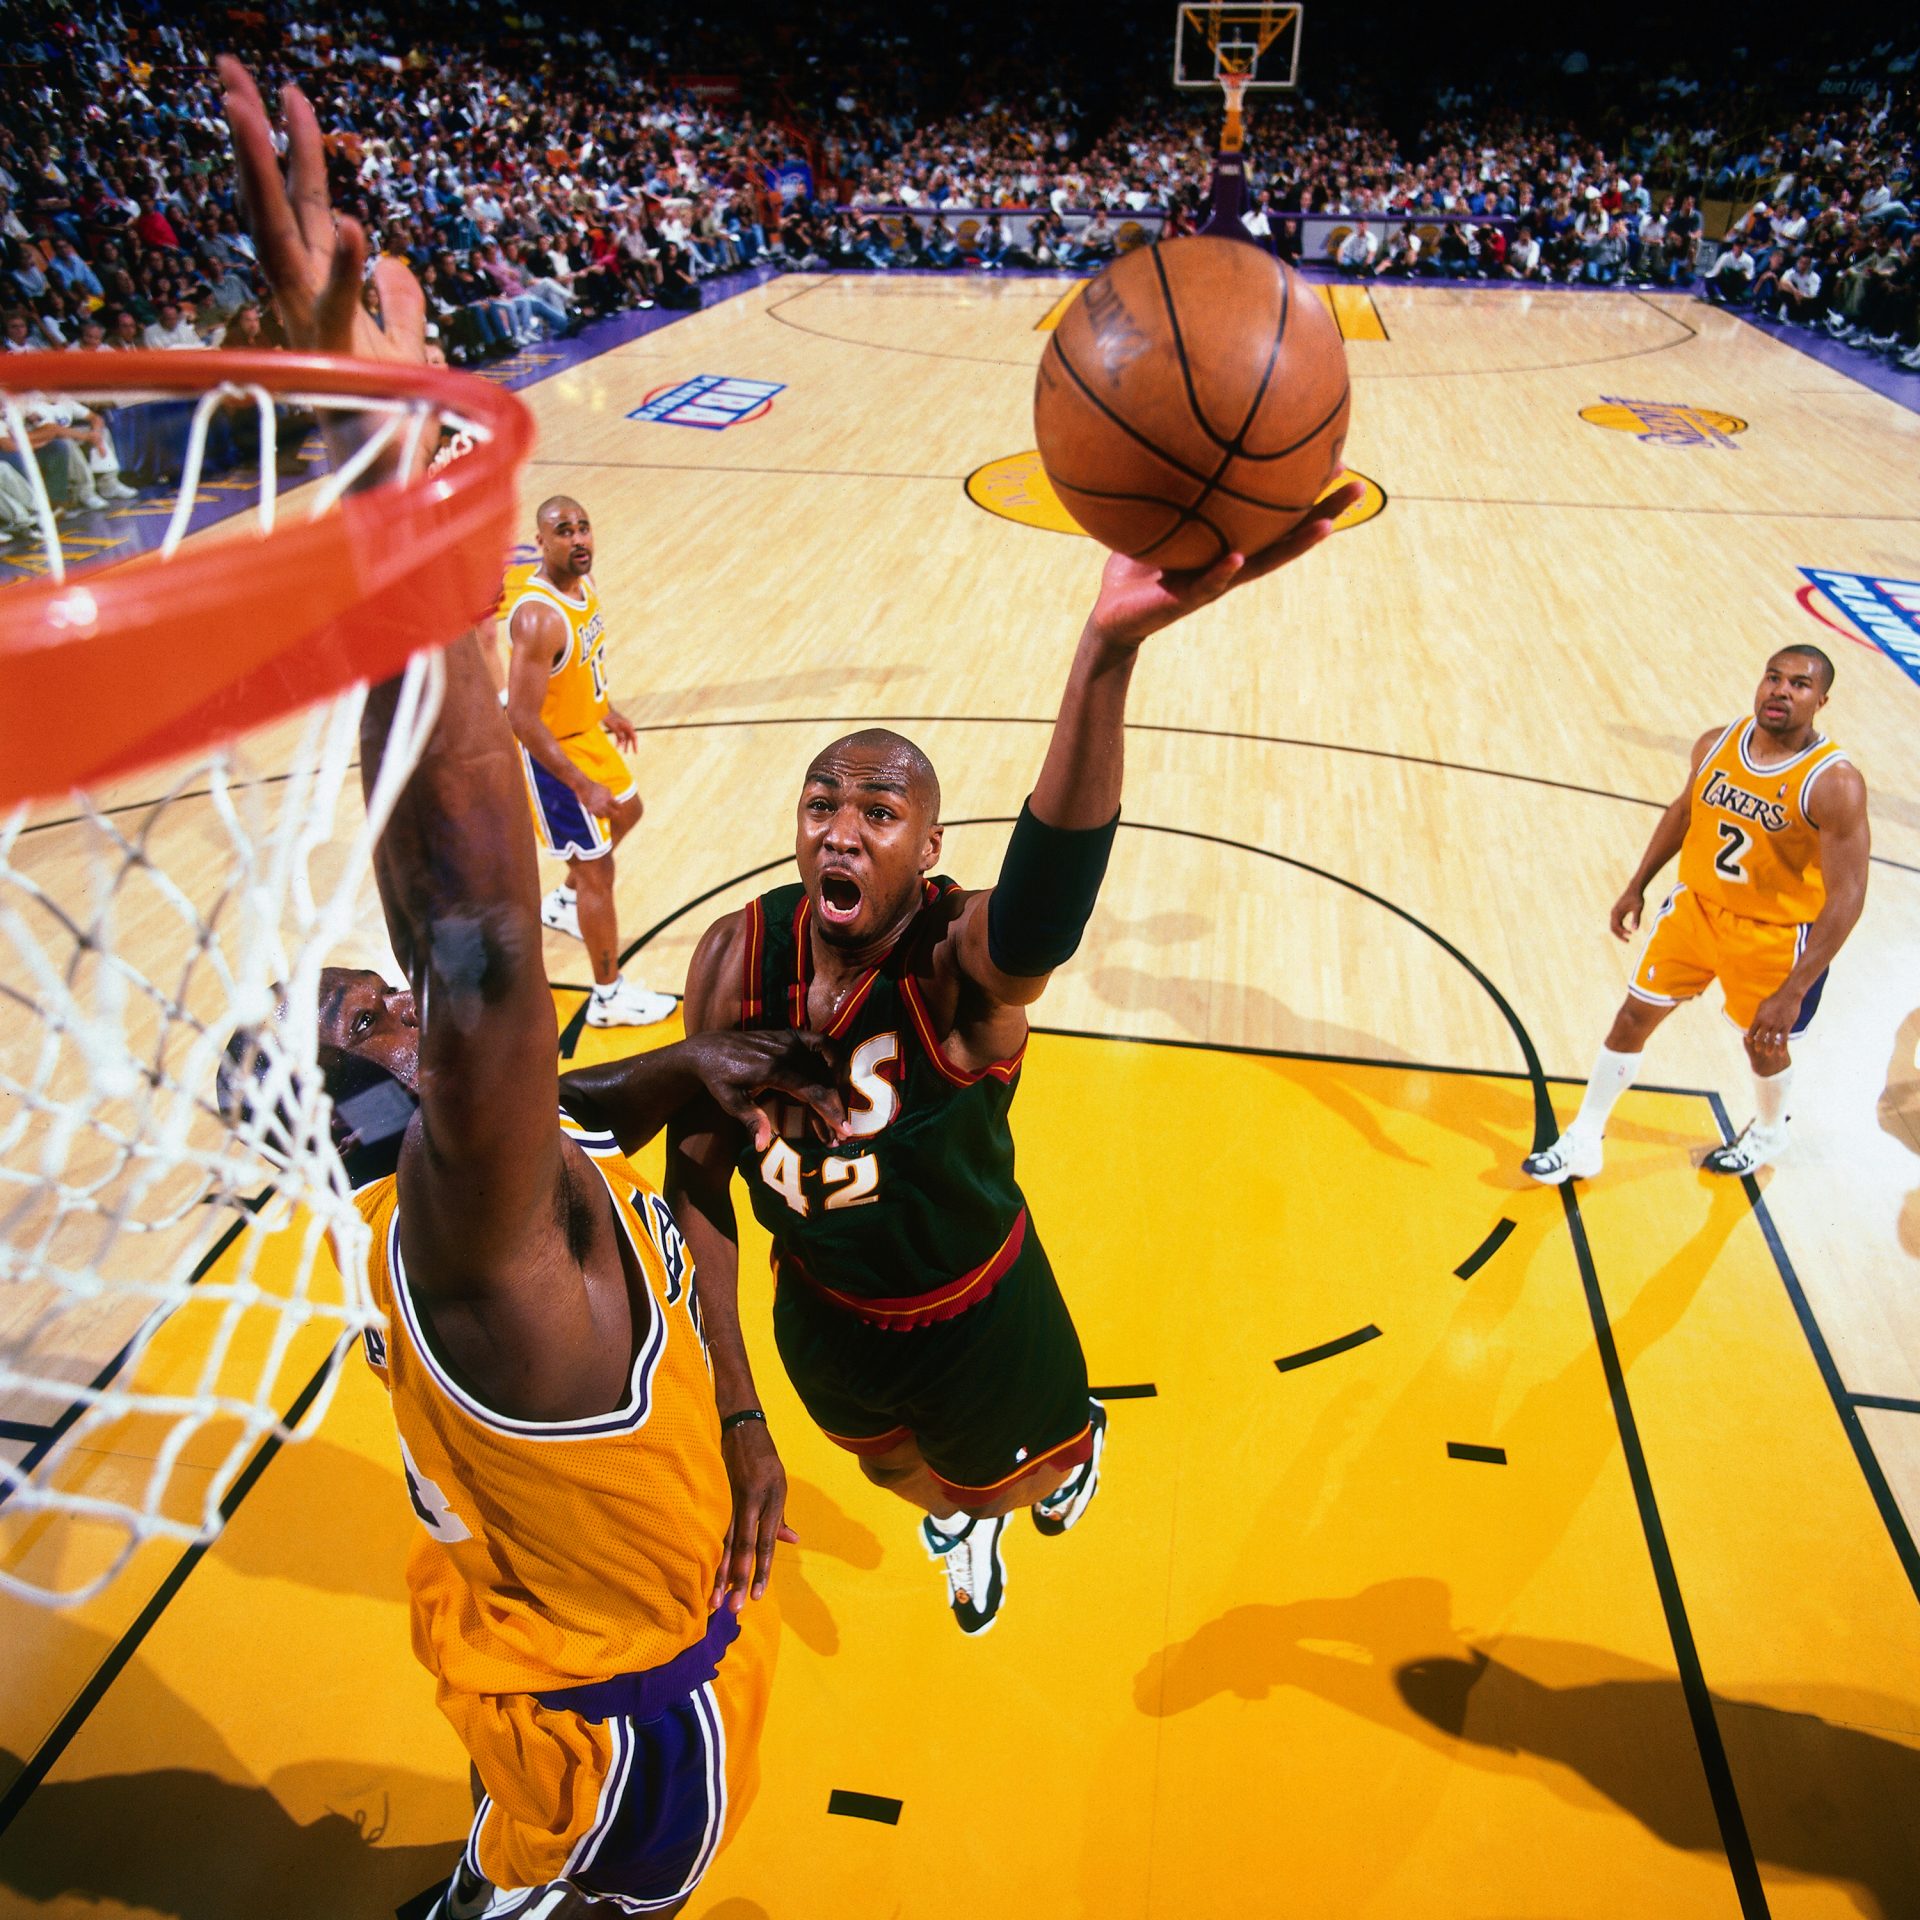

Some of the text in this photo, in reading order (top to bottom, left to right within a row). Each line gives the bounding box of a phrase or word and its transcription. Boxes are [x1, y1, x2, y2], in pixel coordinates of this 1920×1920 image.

[1700, 769, 1792, 832] LAKERS
[1715, 820, 1752, 884] 2
[760, 1136, 880, 1220] 42
